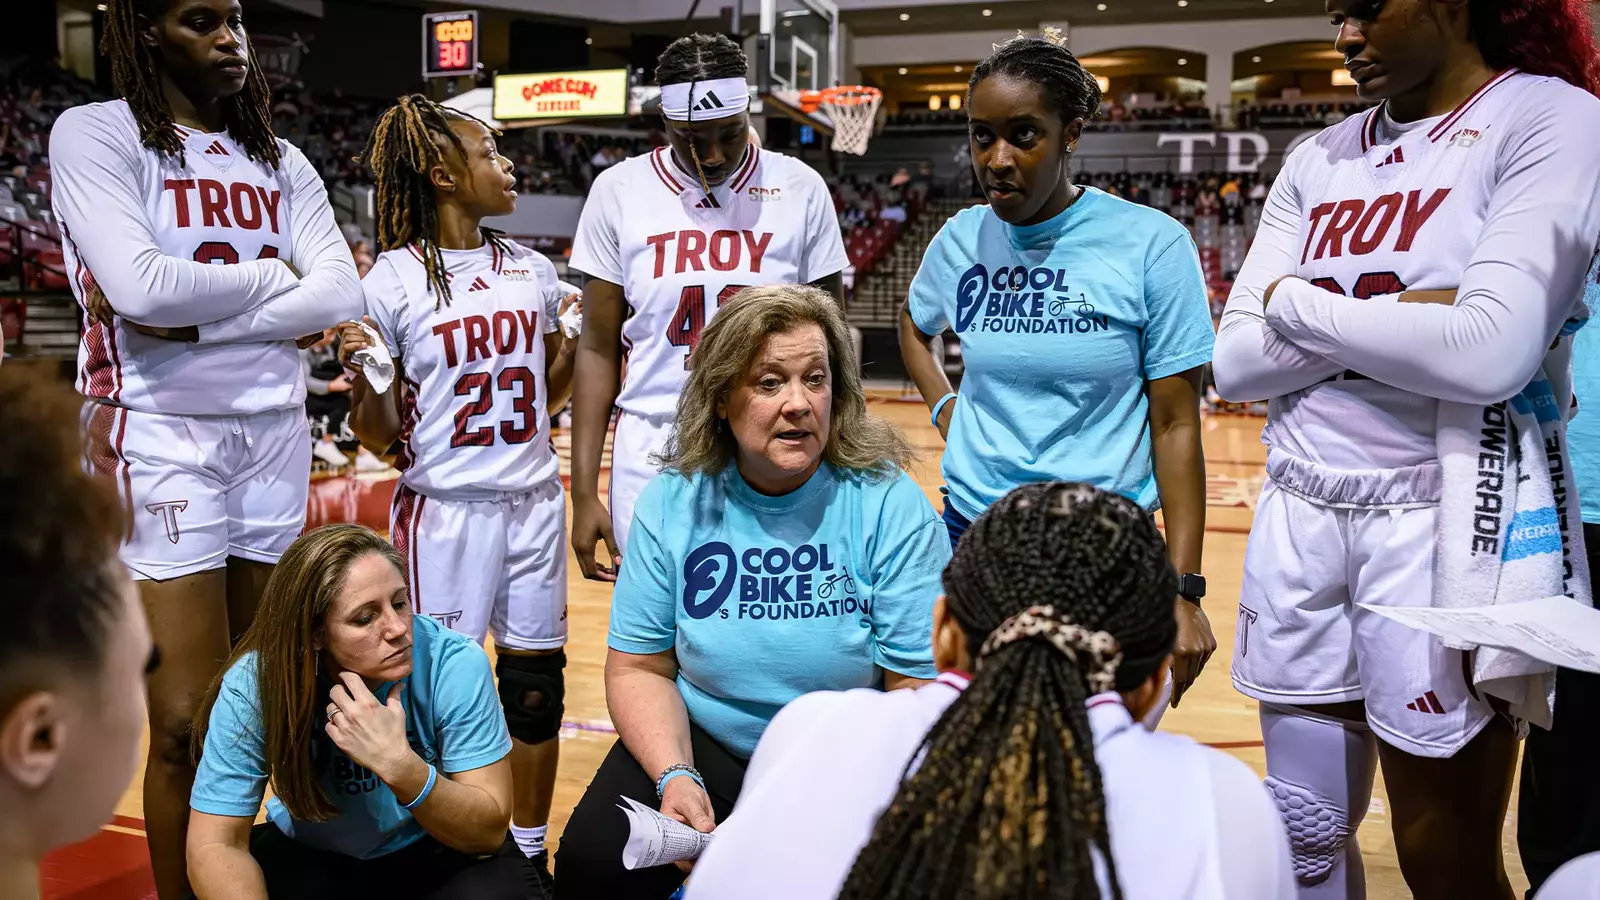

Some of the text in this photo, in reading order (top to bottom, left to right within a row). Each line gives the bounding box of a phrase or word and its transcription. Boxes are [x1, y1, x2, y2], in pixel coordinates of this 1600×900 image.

[439, 41, 467, 67] 30
[164, 179, 281, 235] TROY
[1300, 187, 1453, 267] TROY
[646, 229, 774, 280] TROY
[991, 265, 1069, 293] COOL
[985, 292, 1045, 318] BIKE
[432, 309, 538, 369] TROY
[981, 315, 1109, 334] FOUNDATION
[450, 366, 538, 449] 23
[741, 543, 834, 575] COOL
[739, 573, 813, 604] BIKE
[738, 596, 873, 620] FOUNDATION
